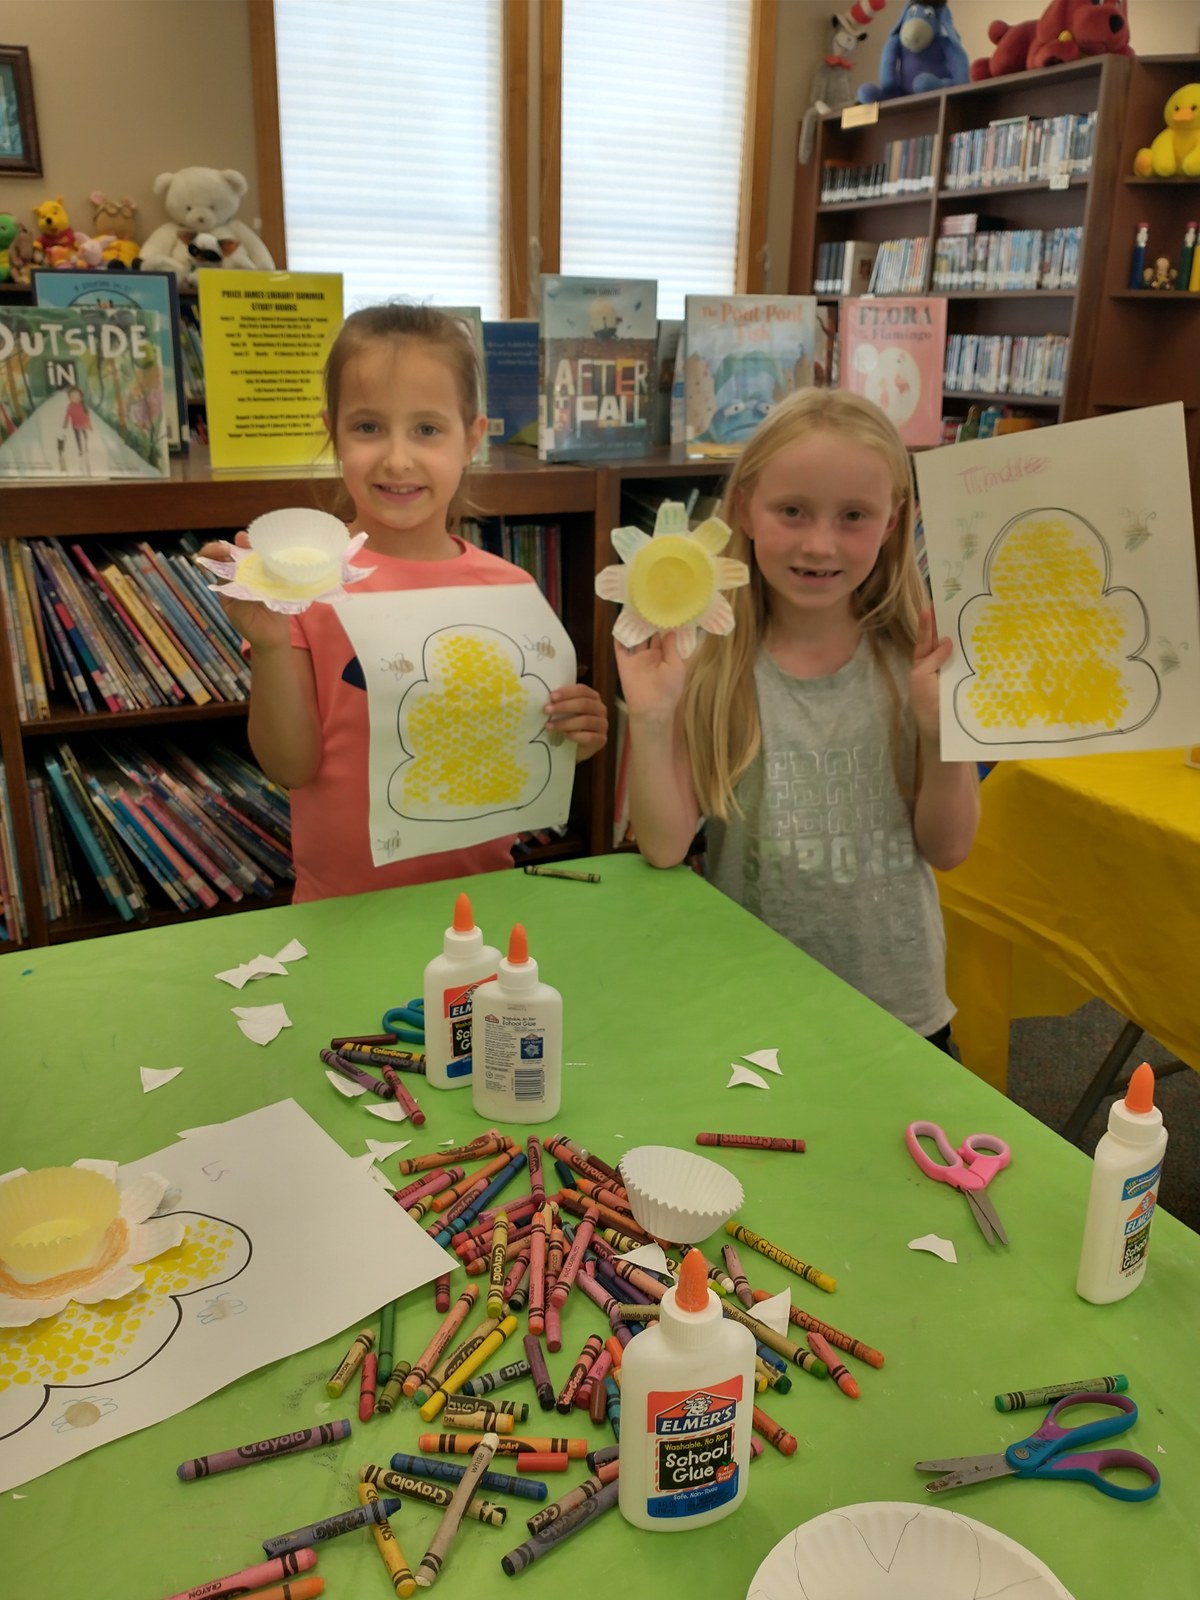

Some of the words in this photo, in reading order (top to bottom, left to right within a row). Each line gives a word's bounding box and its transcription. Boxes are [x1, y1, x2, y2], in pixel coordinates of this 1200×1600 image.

[859, 305, 934, 326] FLORA
[554, 359, 649, 397] AFTER
[573, 1155, 606, 1180] Crayola
[493, 1244, 505, 1281] Crayola
[756, 1239, 806, 1274] Crayons
[797, 1310, 852, 1350] Crayons
[661, 1406, 733, 1432] ELMER'S
[240, 1430, 306, 1454] Crayola
[716, 1433, 728, 1442] Run
[471, 1452, 485, 1473] white
[665, 1440, 728, 1468] School
[672, 1465, 714, 1482] Glue
[391, 1474, 448, 1505] Crayola
[188, 1582, 222, 1599] CRAYON
